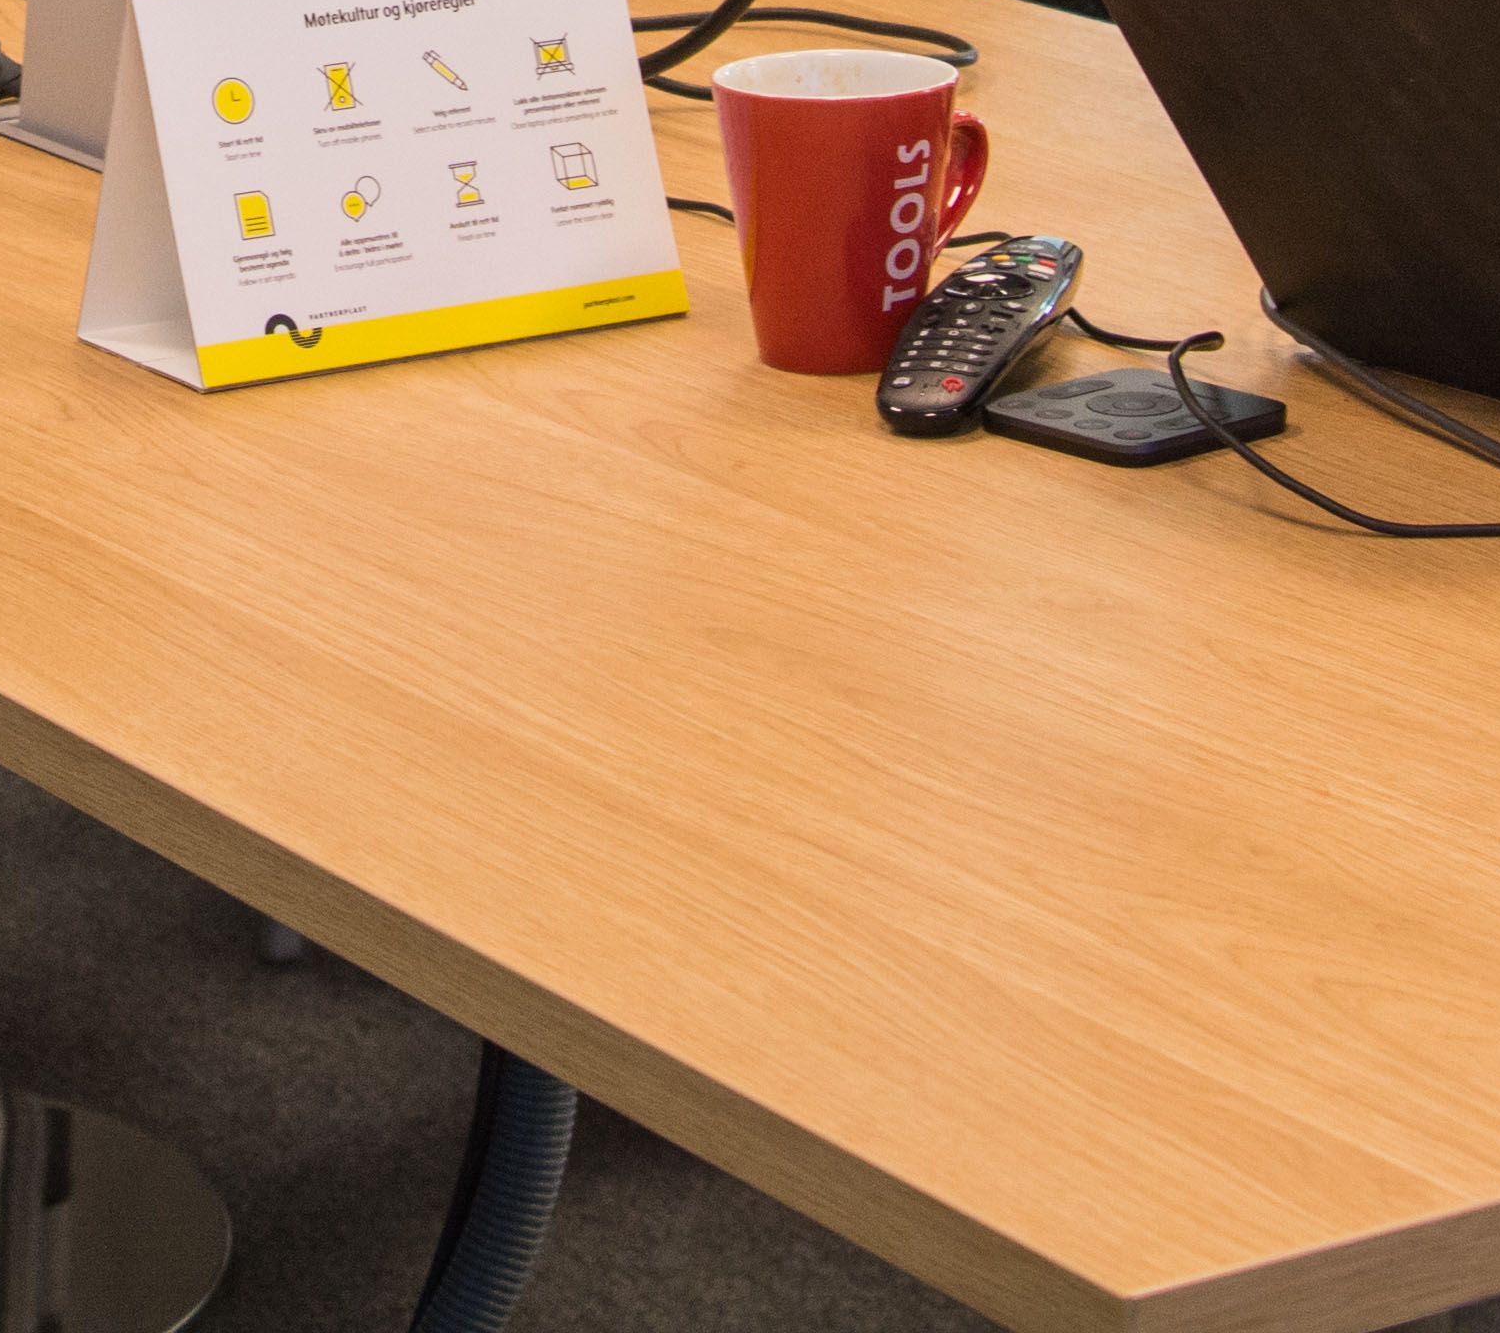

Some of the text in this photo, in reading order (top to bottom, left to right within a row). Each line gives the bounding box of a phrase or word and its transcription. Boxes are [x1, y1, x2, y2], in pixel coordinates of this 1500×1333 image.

[304, 7, 379, 28] Møtekultur
[383, 6, 400, 20] og
[882, 139, 931, 312] TOOLS
[309, 306, 366, 319] PARTNERPLAST
